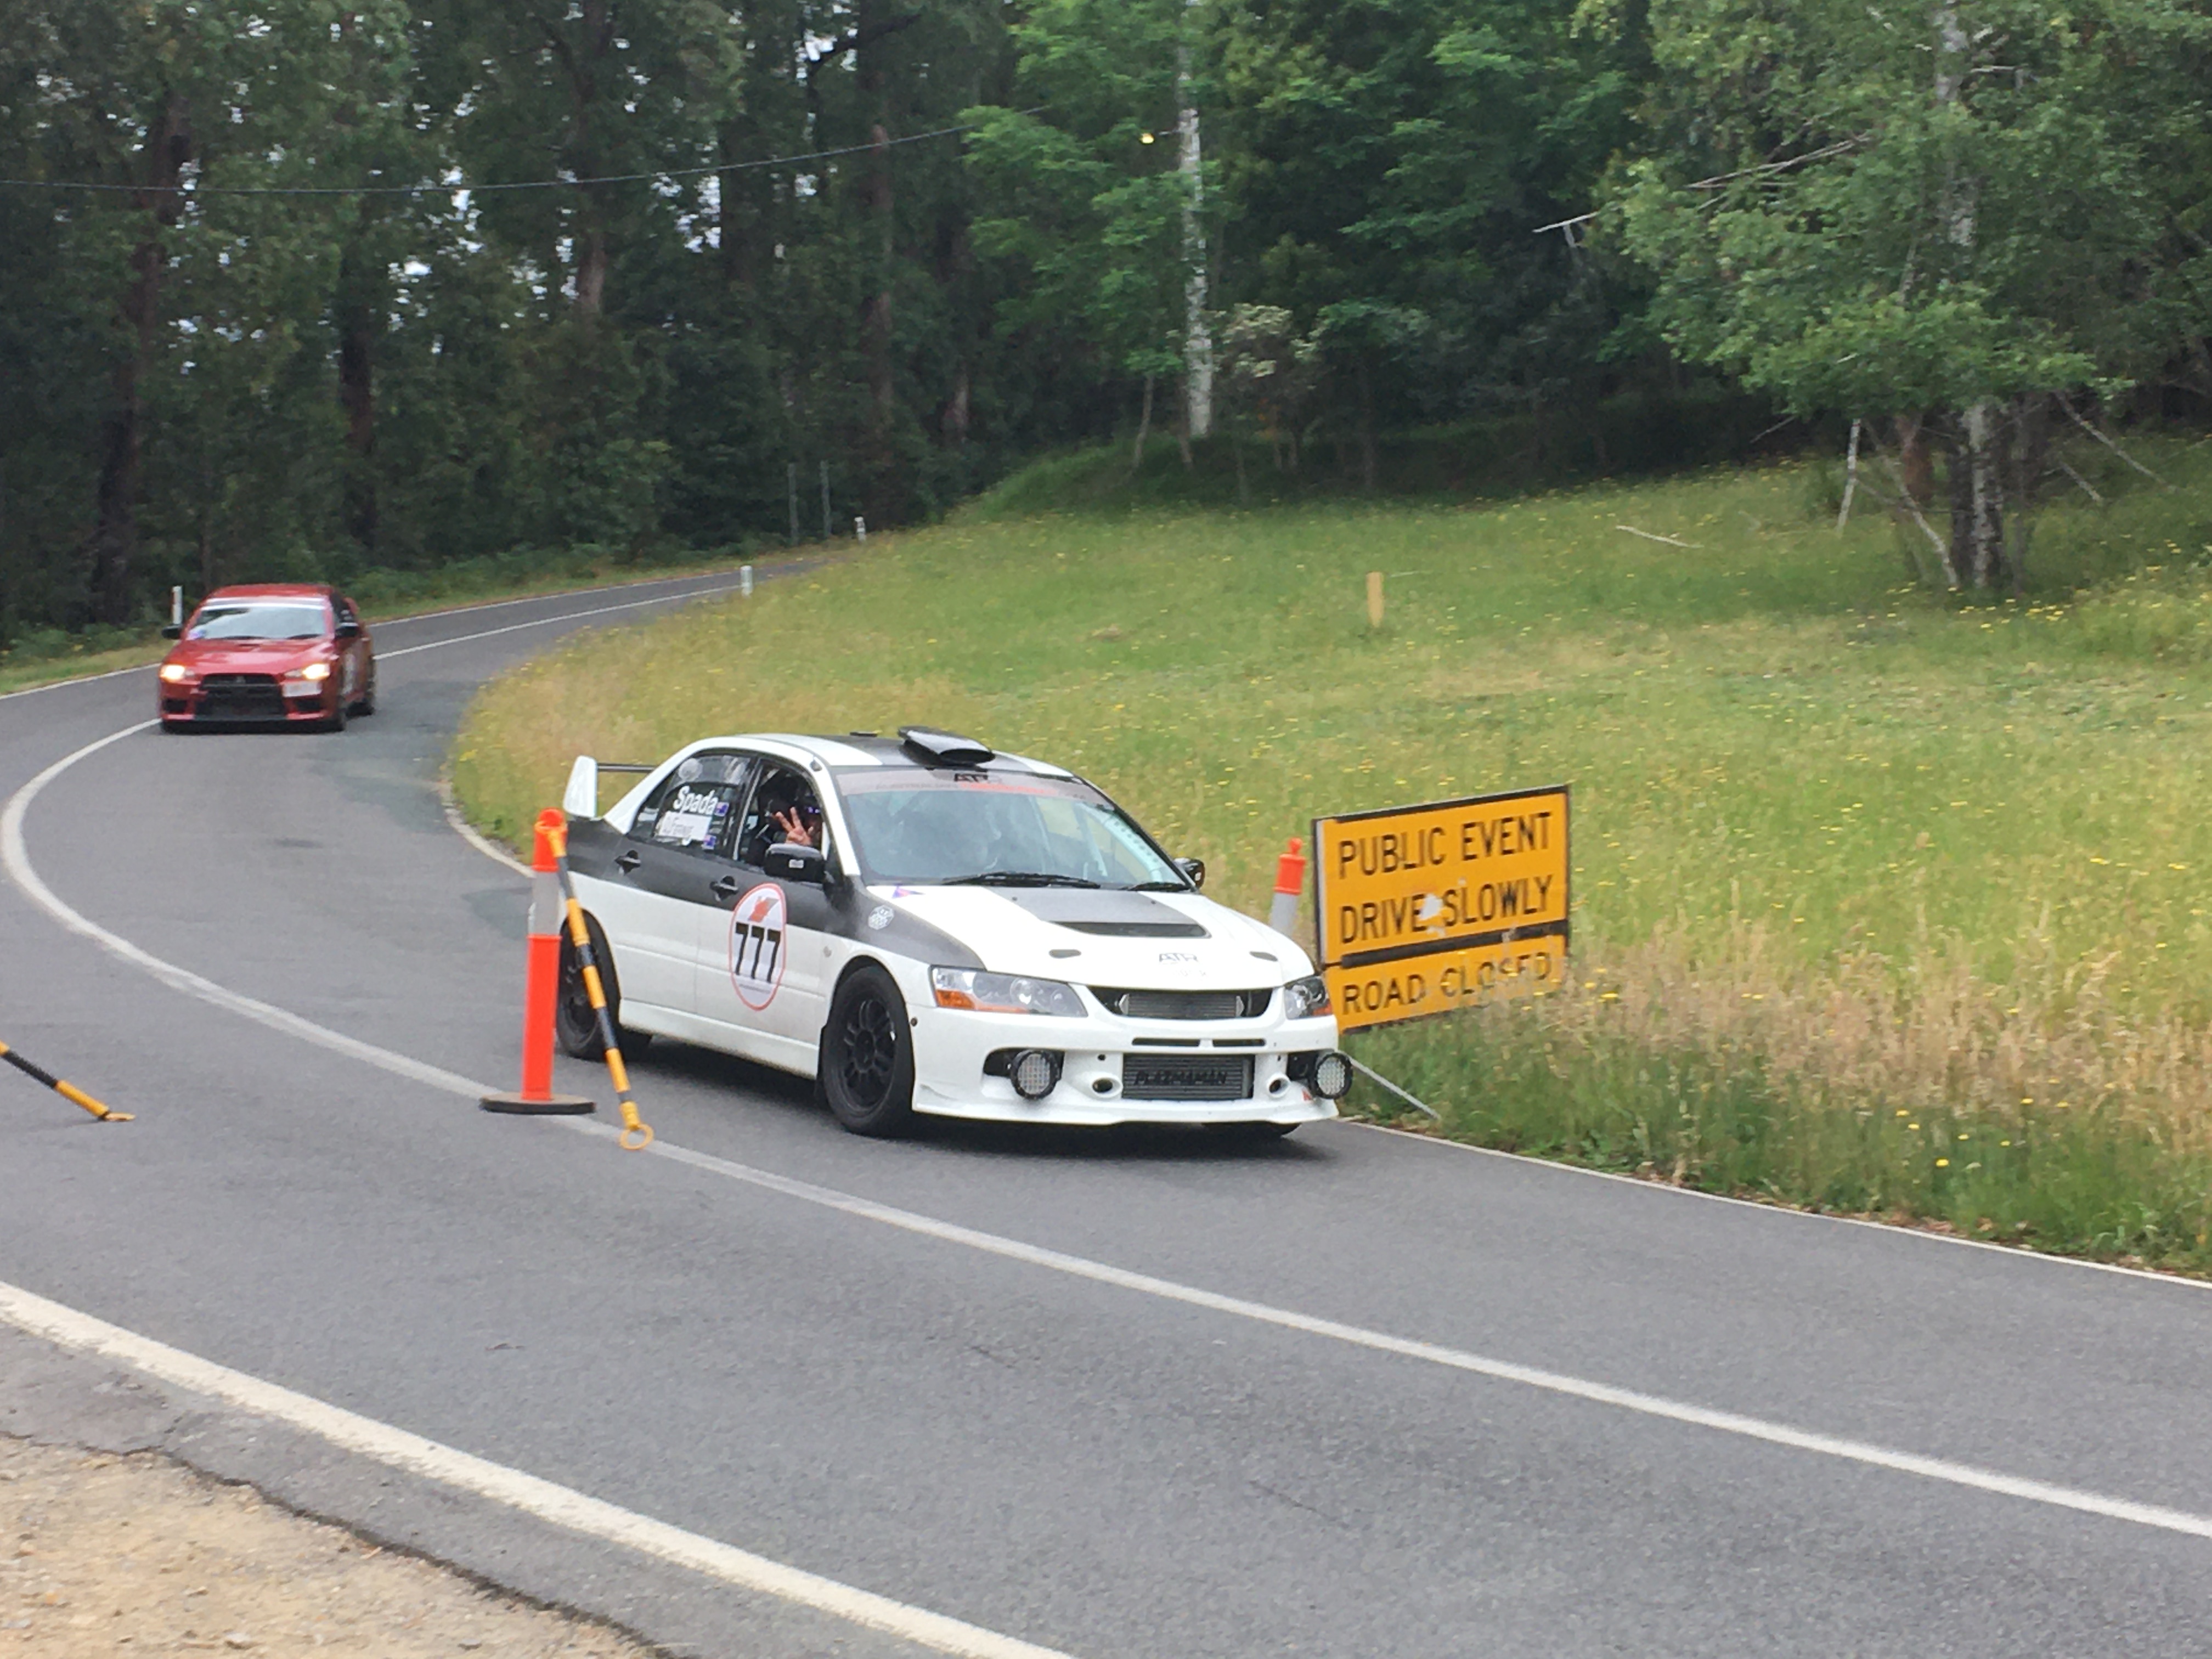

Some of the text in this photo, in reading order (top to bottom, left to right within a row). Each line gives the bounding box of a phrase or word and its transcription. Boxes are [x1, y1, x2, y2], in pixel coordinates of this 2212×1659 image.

[673, 786, 719, 815] Spada
[1339, 811, 1551, 879] PUBLIC EVENT
[1340, 874, 1553, 944] DRIVE SLOWLY
[735, 922, 781, 984] 777
[1342, 974, 1425, 1014] ROAD
